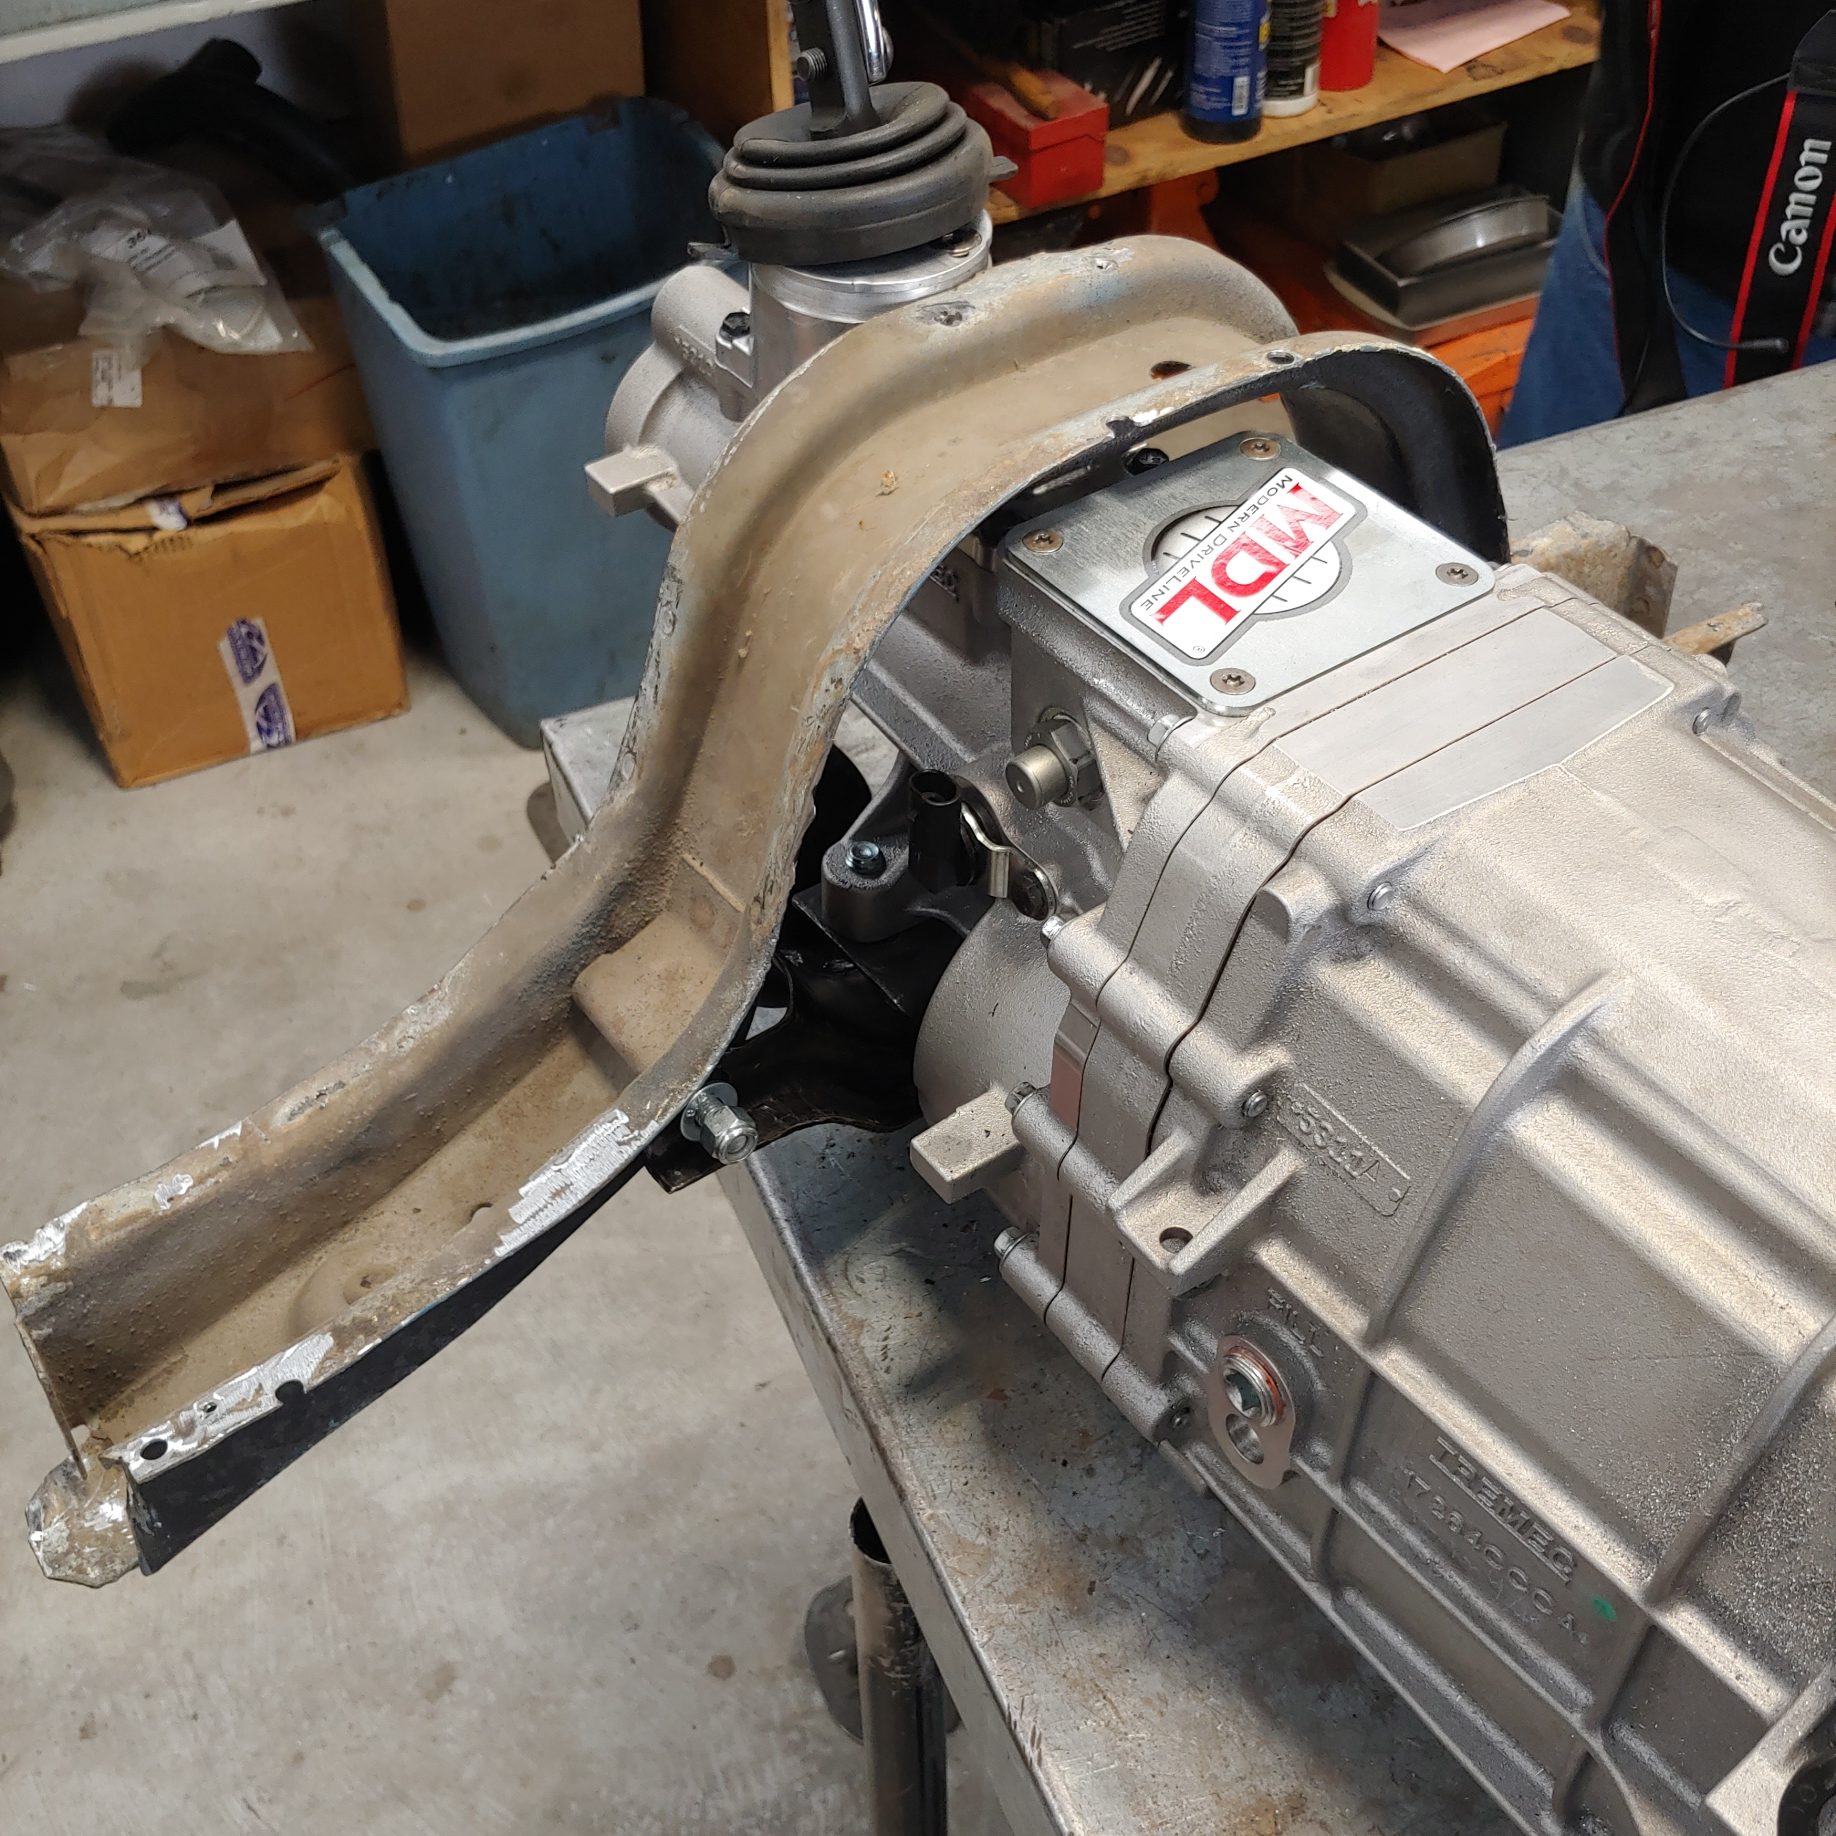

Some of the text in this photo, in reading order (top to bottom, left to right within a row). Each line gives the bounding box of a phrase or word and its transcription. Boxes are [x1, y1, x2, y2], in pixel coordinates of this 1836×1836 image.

[1768, 138, 1833, 276] Canon
[1140, 474, 1294, 611] MODERN DRIVELINE
[1151, 482, 1344, 625] MDL
